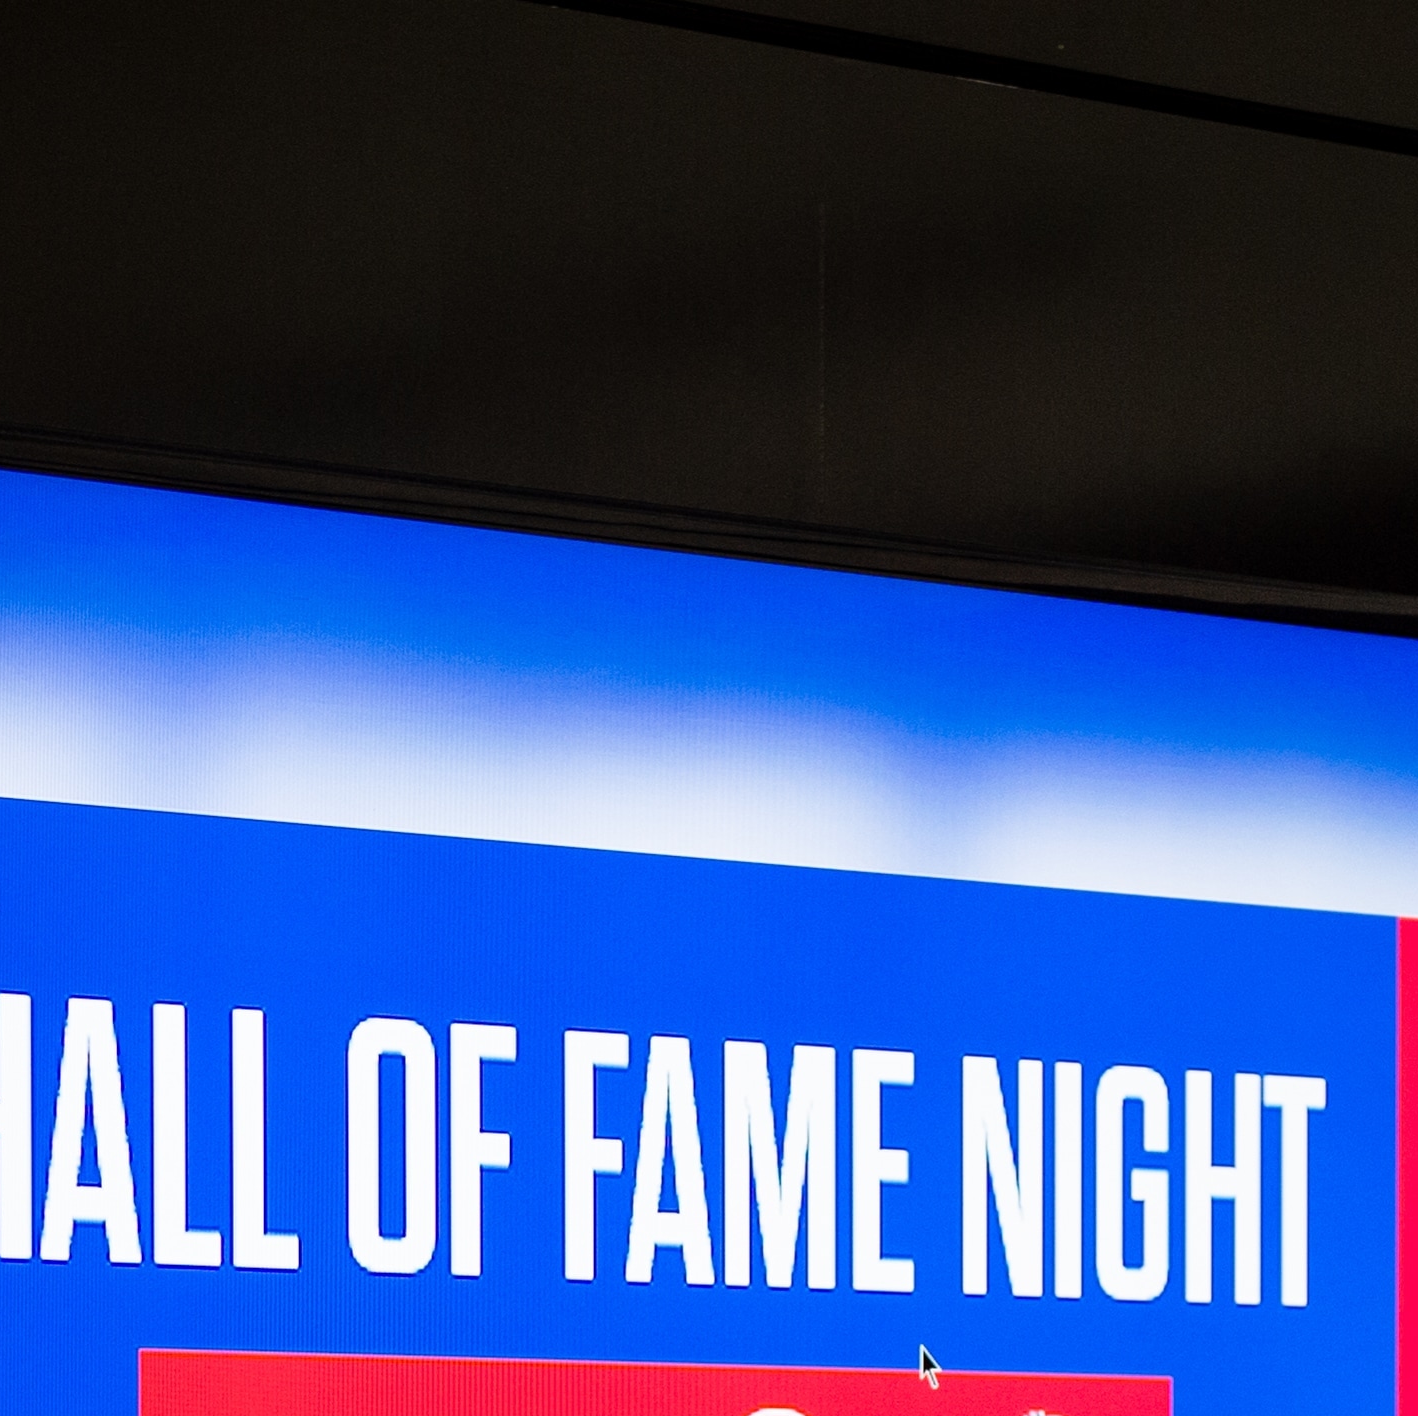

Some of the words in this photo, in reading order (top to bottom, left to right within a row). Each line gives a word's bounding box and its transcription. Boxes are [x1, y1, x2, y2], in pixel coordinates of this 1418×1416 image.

[347, 1015, 518, 1277] OF
[564, 1029, 915, 1293] FAME
[962, 1055, 1327, 1308] NIGHT
